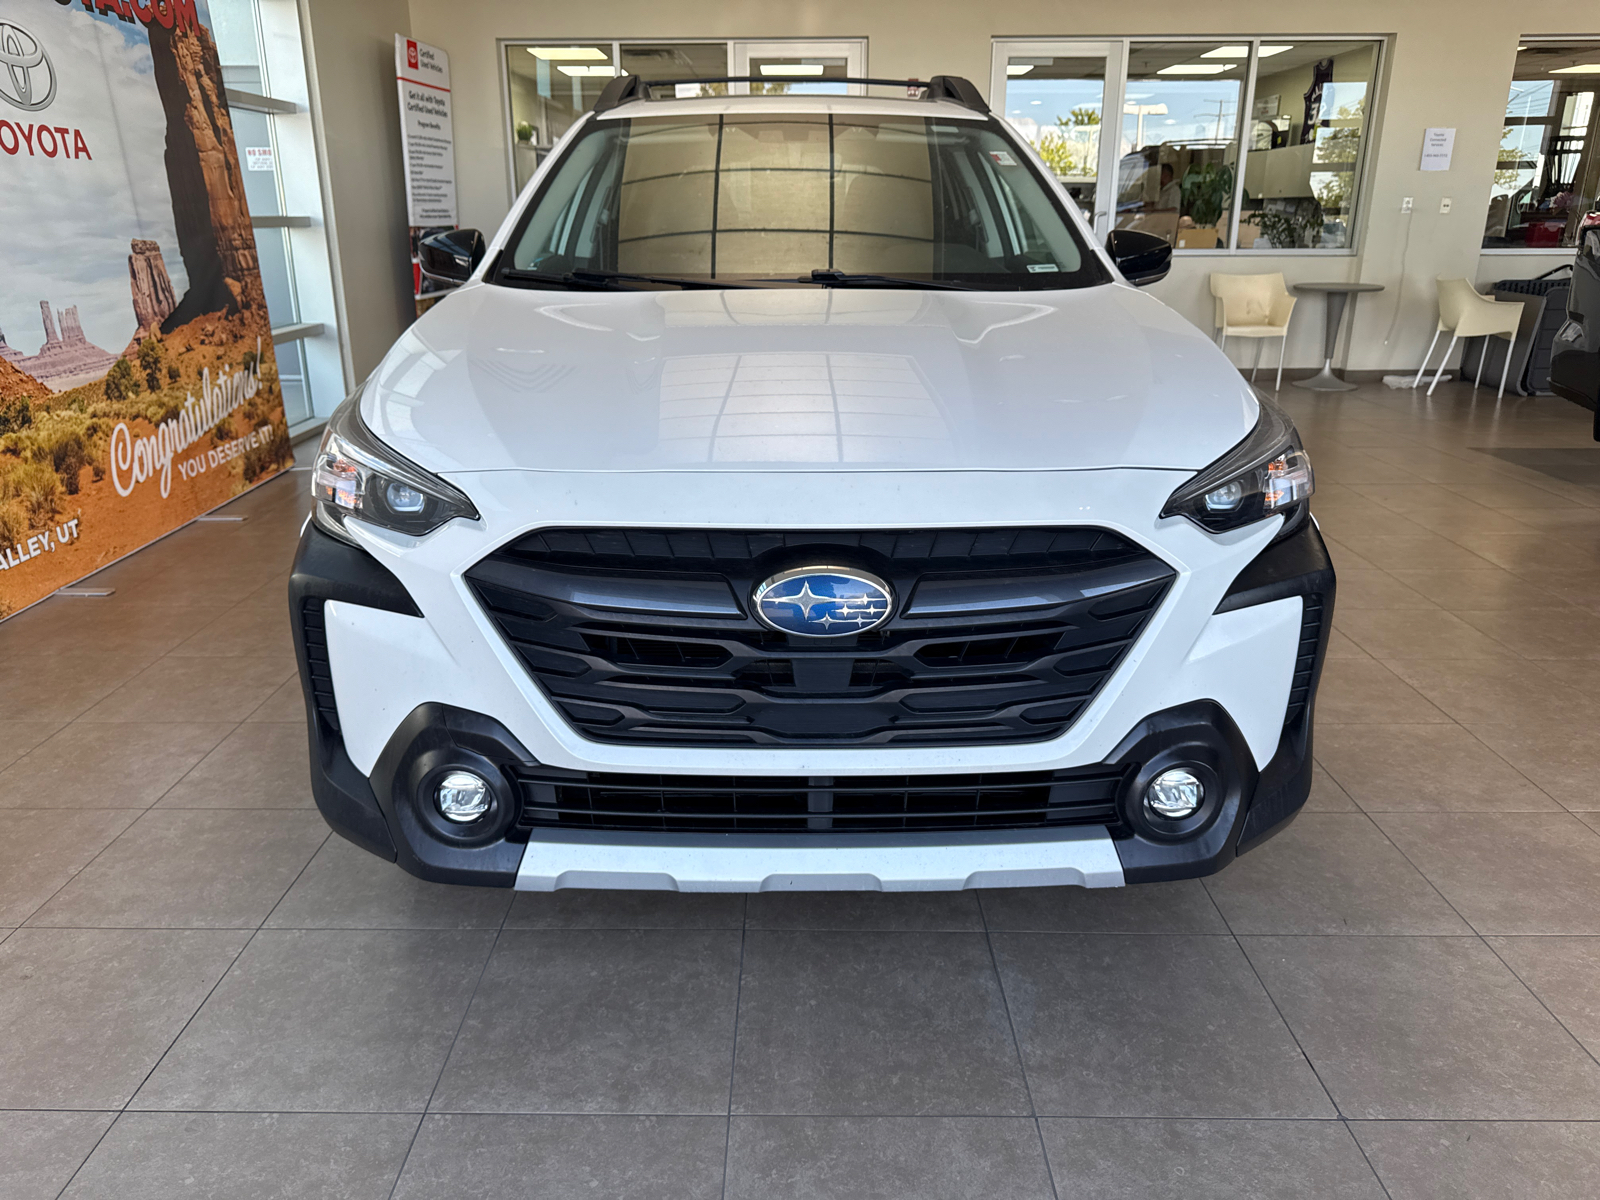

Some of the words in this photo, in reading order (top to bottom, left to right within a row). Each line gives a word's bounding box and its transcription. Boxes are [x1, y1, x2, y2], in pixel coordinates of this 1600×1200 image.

[110, 335, 263, 499] Congratulations!
[178, 454, 206, 481] YOU
[207, 431, 259, 469] DESERVE
[258, 424, 274, 445] IT!
[56, 518, 79, 543] UT
